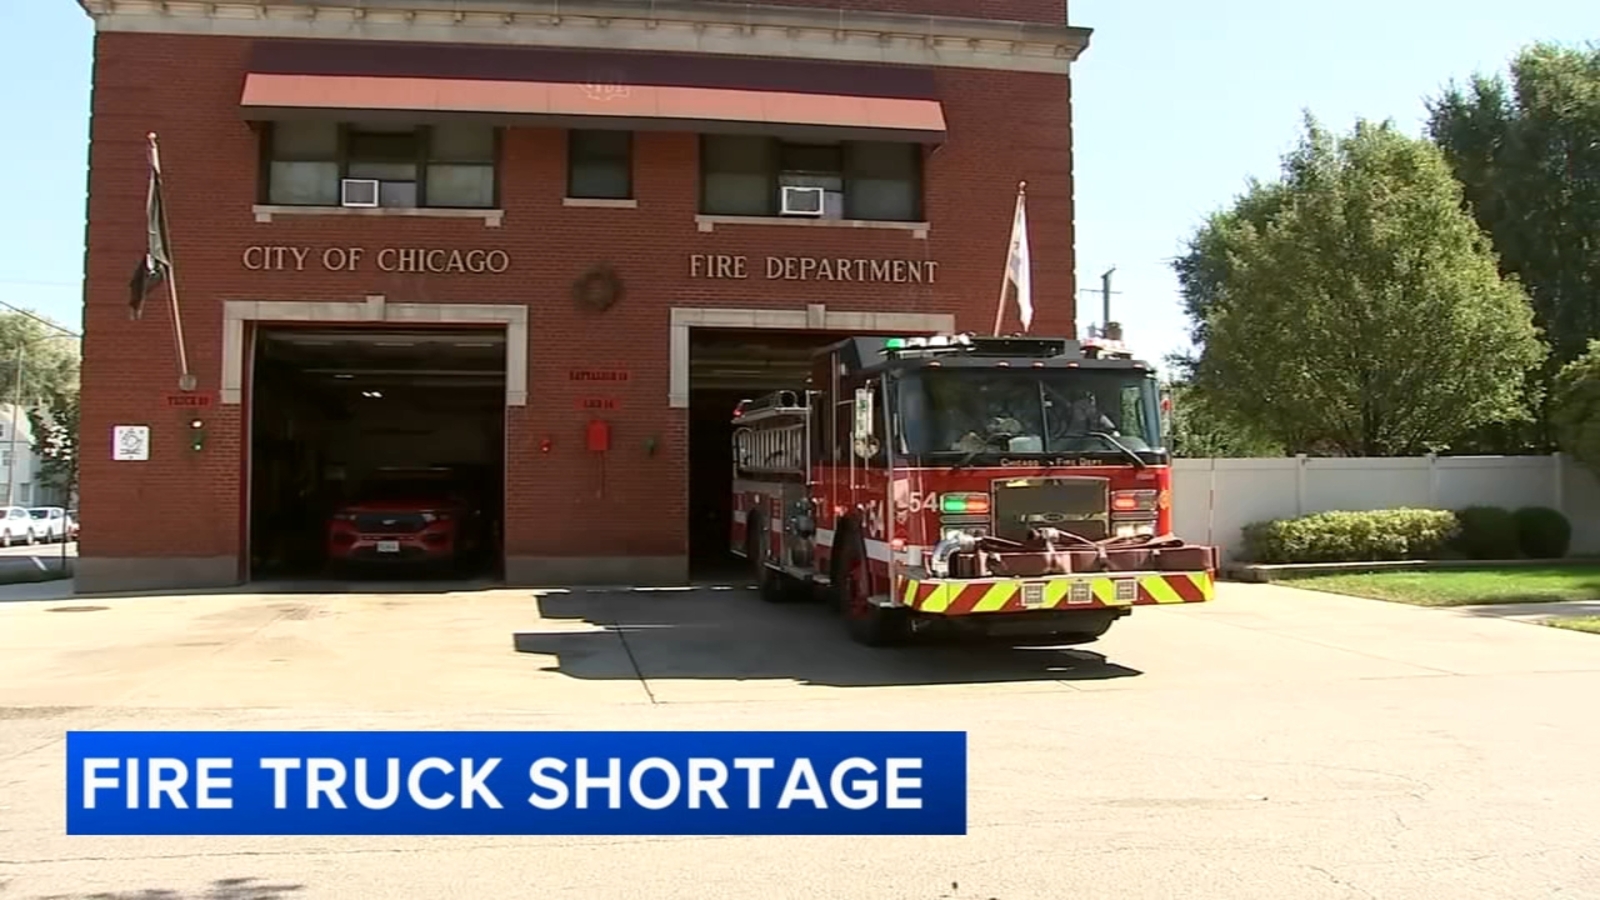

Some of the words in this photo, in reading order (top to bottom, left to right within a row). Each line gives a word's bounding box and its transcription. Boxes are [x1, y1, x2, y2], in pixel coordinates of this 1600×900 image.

[243, 246, 311, 271] CITY
[322, 247, 365, 271] OF
[377, 248, 510, 273] CHICAGO
[690, 254, 748, 279] FIRE
[765, 256, 939, 284] DEPARTMENT
[909, 491, 939, 513] 54
